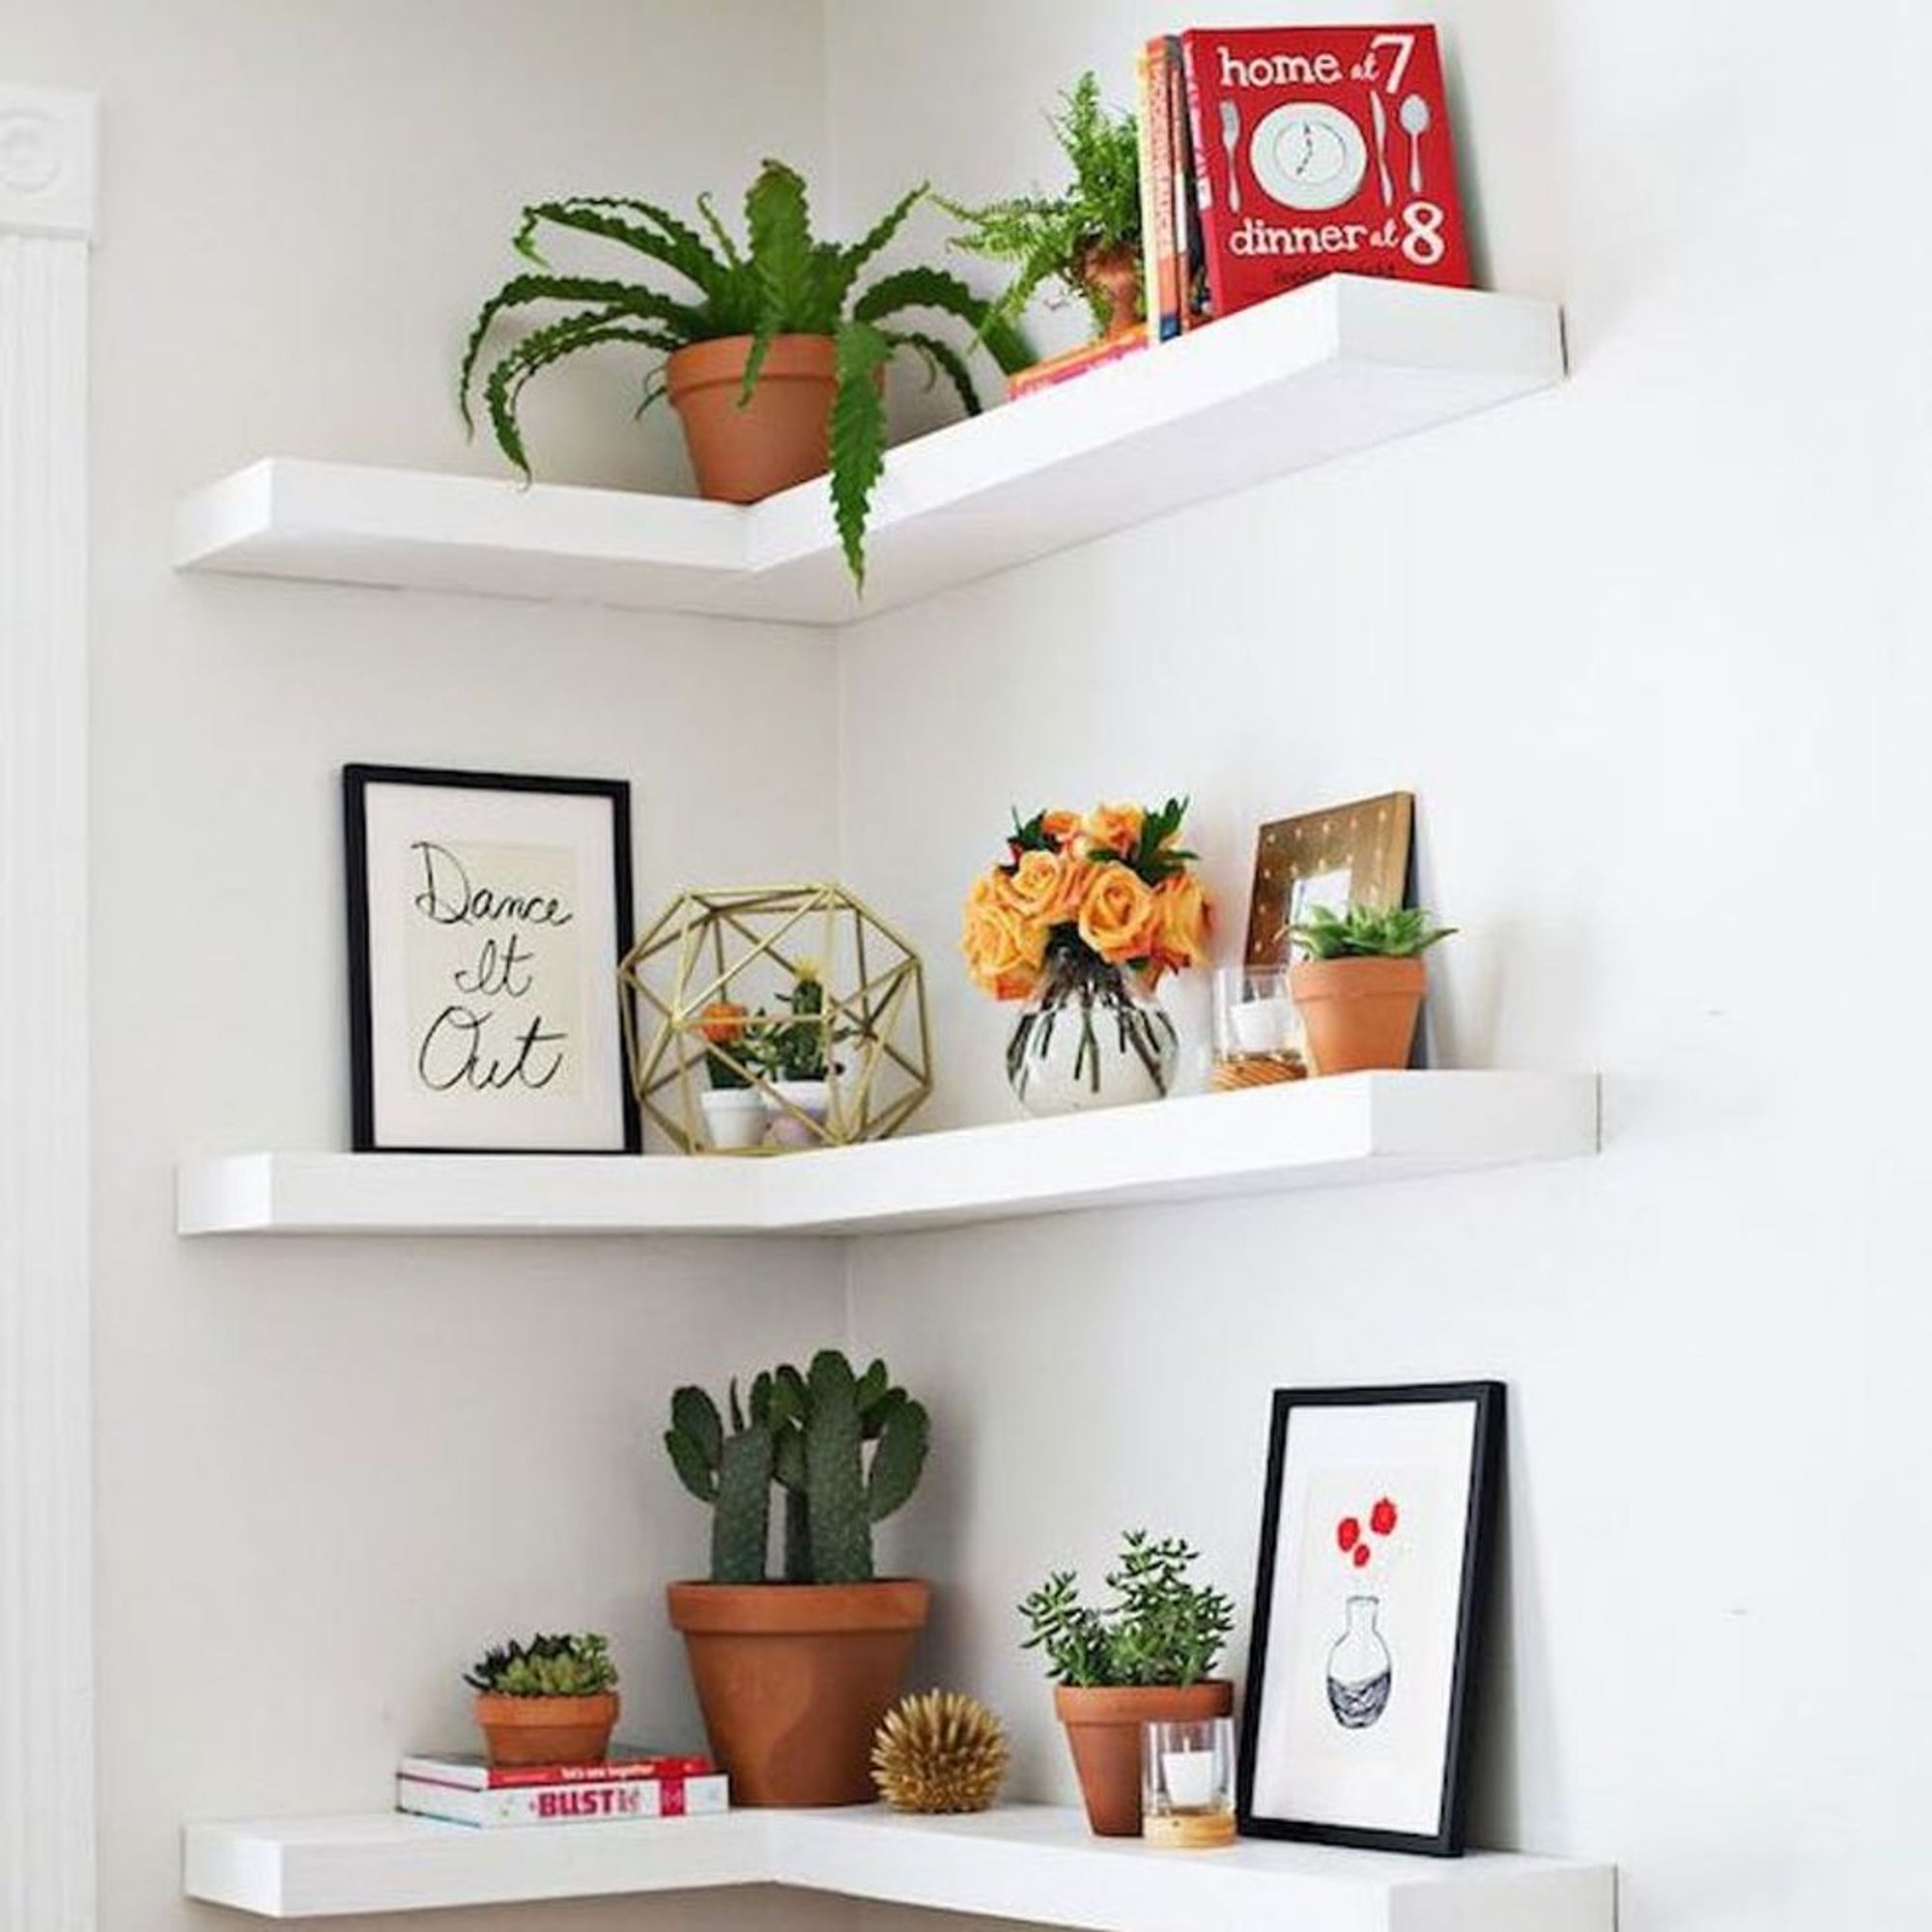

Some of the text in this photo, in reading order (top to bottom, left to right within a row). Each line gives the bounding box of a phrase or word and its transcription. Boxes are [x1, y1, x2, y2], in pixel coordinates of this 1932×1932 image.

[1217, 34, 1415, 95] home at 7
[1229, 200, 1445, 266] dinner at 8
[411, 840, 573, 926] Dance
[454, 933, 535, 998] It
[418, 1006, 569, 1092] Out
[539, 1788, 615, 1818] BUST
